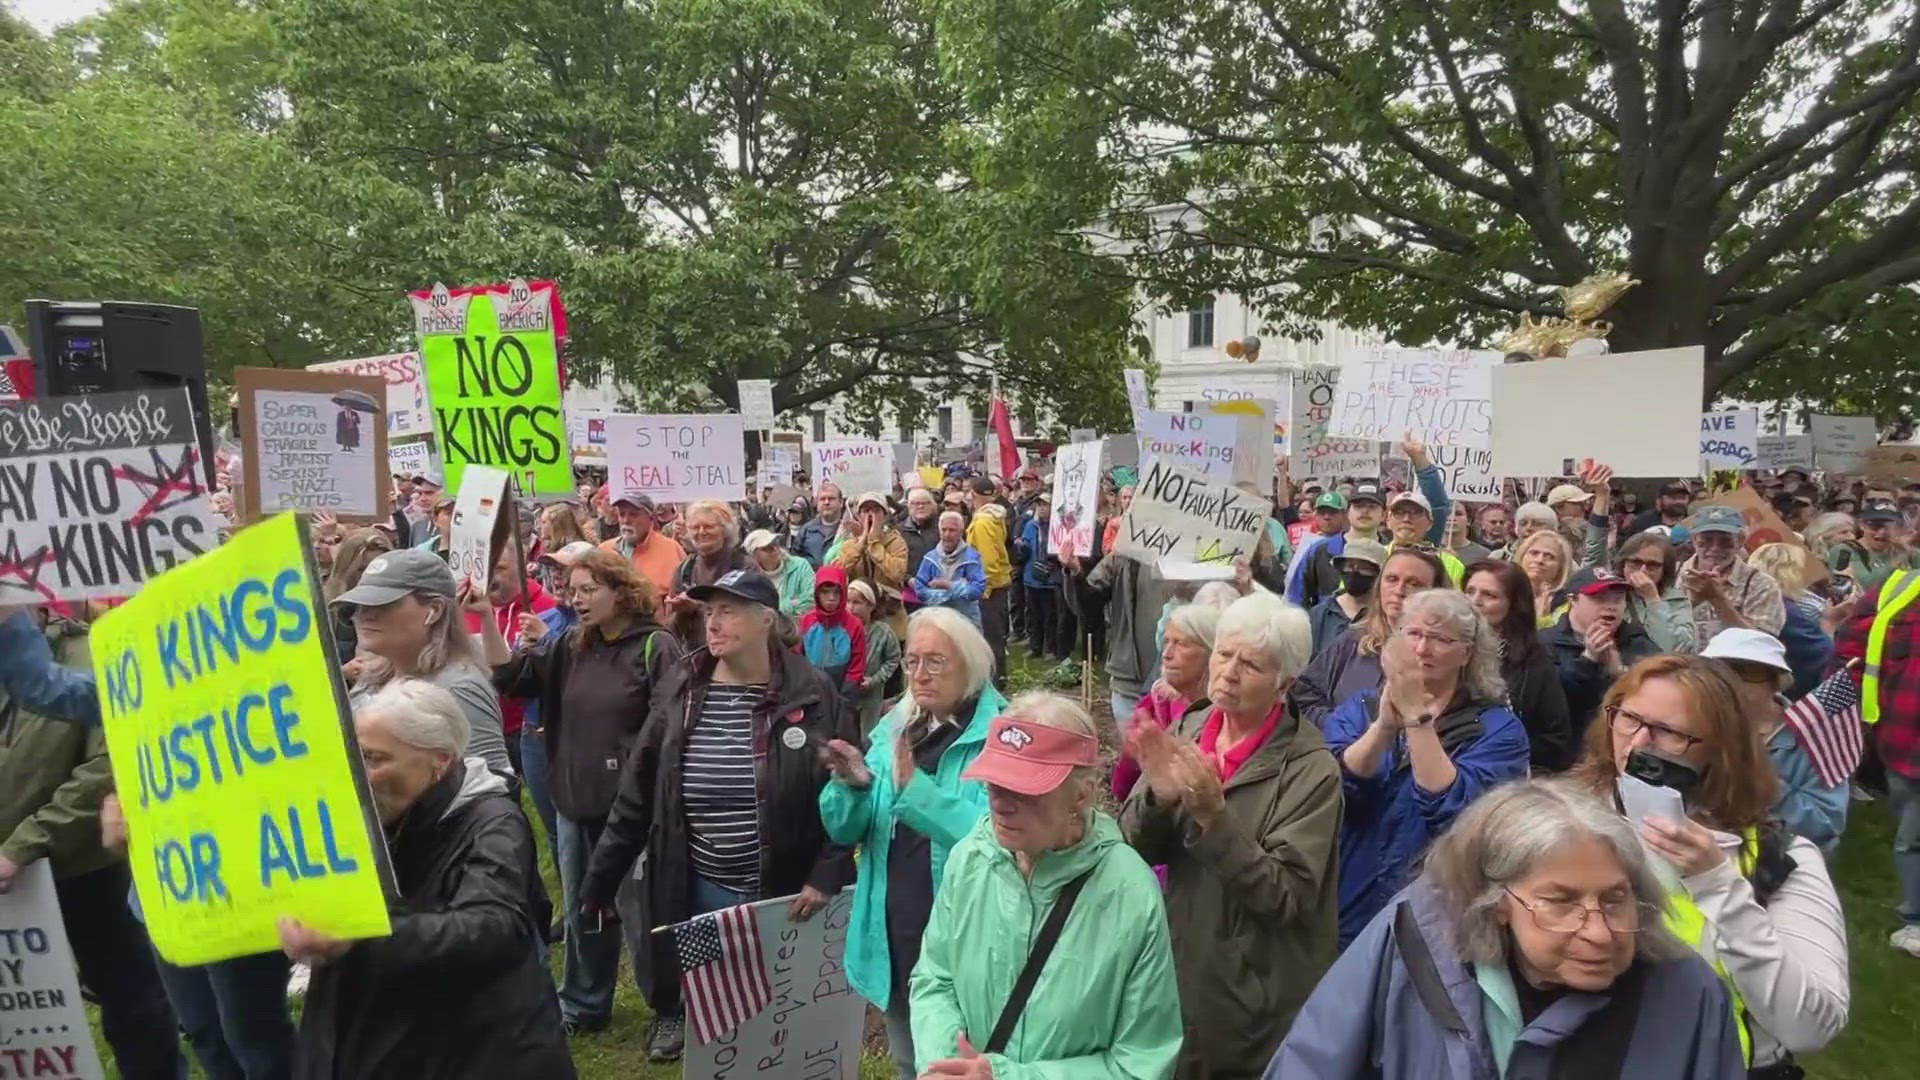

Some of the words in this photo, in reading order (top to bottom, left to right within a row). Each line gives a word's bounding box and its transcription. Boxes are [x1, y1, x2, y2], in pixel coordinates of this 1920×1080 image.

[432, 294, 447, 308] NO
[511, 288, 528, 303] NO
[453, 335, 533, 398] NO
[1363, 361, 1469, 388] THESE
[1368, 381, 1395, 395] ARE
[1413, 384, 1454, 397] WHAT
[62, 395, 173, 450] People
[1171, 415, 1203, 431] NO
[1342, 391, 1493, 434] PATRIOTS
[261, 421, 327, 437] CALLOUS
[436, 405, 561, 467] KINGS
[636, 426, 713, 448] STOP
[263, 438, 318, 454] FRAGILE
[671, 451, 690, 460] THE
[279, 453, 334, 468] RACIST
[400, 461, 420, 471] THE
[49, 456, 120, 519] NO
[292, 479, 336, 494] NAZI
[624, 466, 675, 486] REAL
[682, 466, 739, 486] STEAL
[1142, 462, 1184, 503] NO
[278, 492, 342, 507] POTUS
[1129, 513, 1180, 557] WAY
[50, 514, 206, 588] KINGS
[104, 649, 143, 719] NO
[156, 568, 312, 689] KINGS
[137, 683, 311, 810] JUSTICE
[260, 798, 359, 889] ALL
[0, 958, 24, 987] Y
[758, 928, 807, 1073] Requires
[804, 1040, 839, 1080] UE
